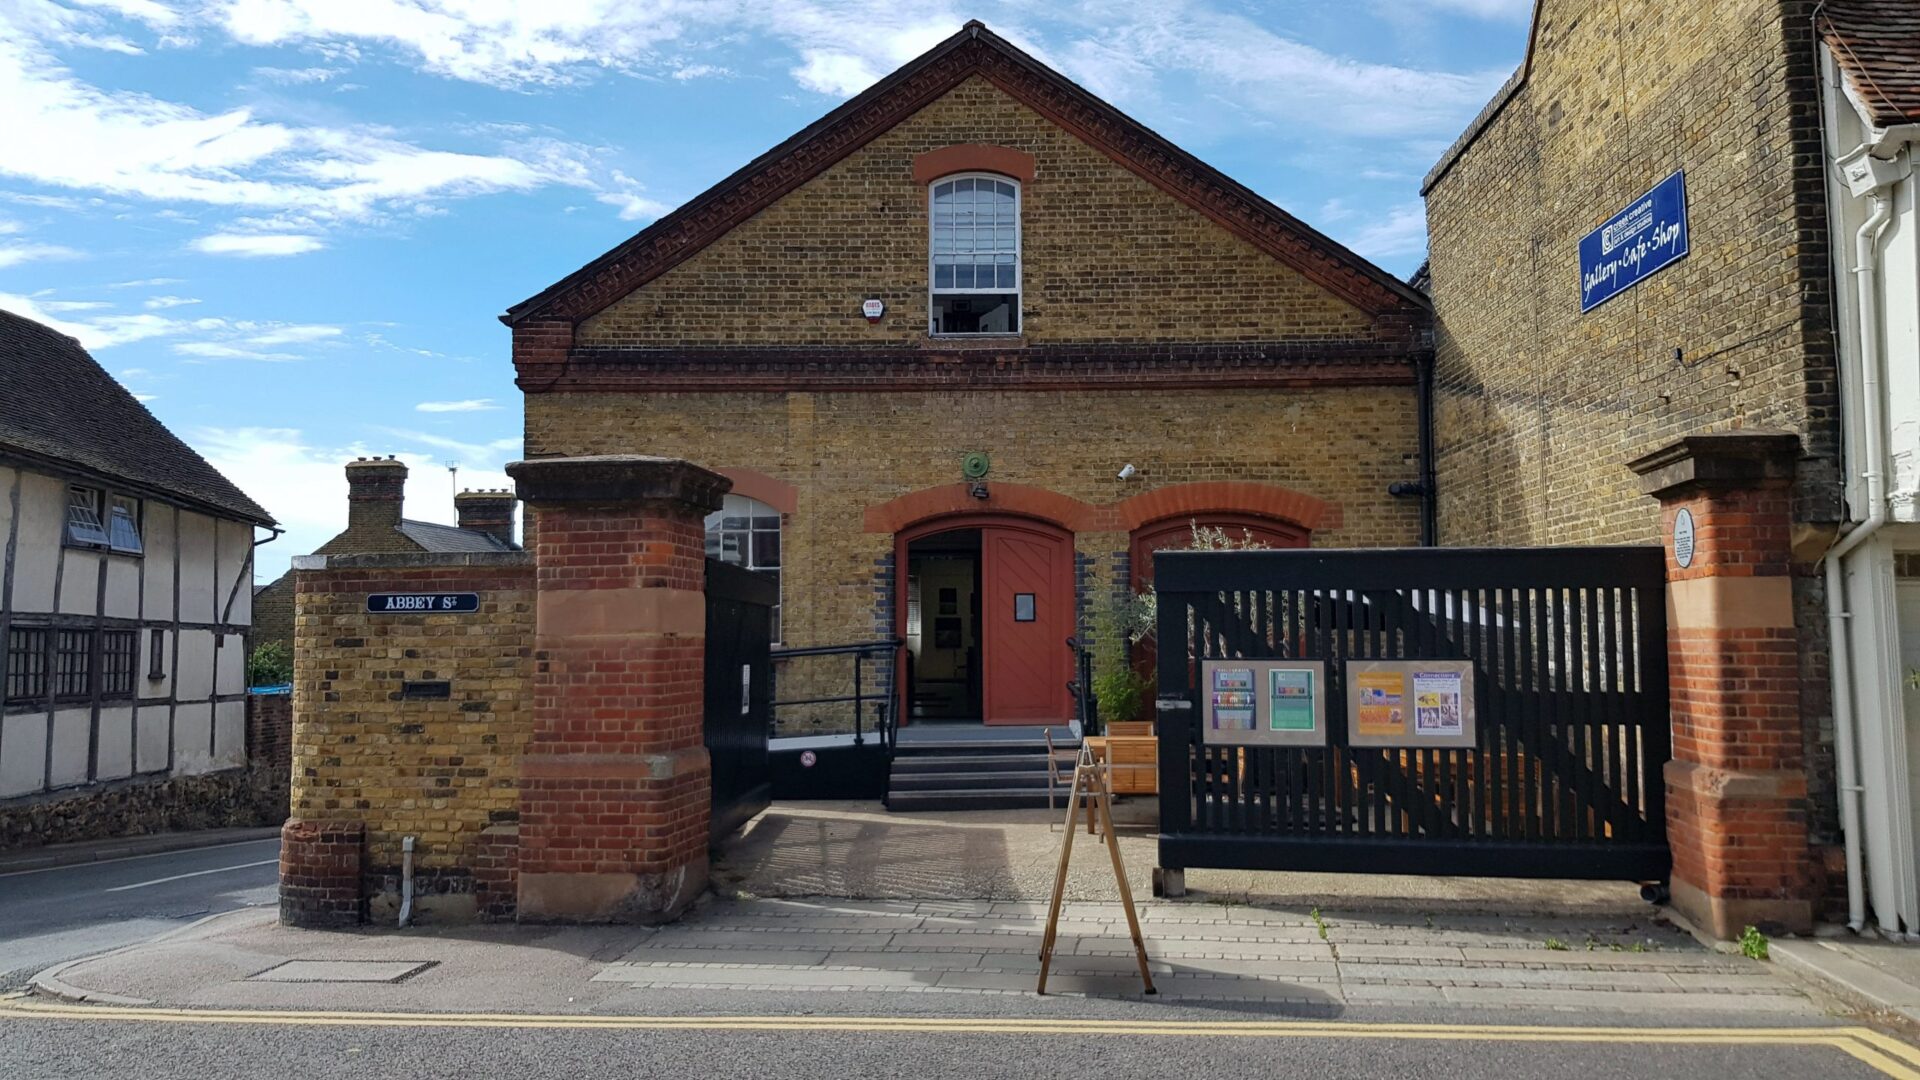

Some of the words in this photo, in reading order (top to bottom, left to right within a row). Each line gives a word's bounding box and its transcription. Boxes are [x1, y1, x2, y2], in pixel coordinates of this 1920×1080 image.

[1613, 214, 1629, 232] creek
[1628, 199, 1653, 220] creative
[1584, 262, 1617, 302] Gallery
[1622, 235, 1647, 275] Cafe
[1652, 220, 1679, 254] Shop
[385, 596, 436, 610] ABBEY
